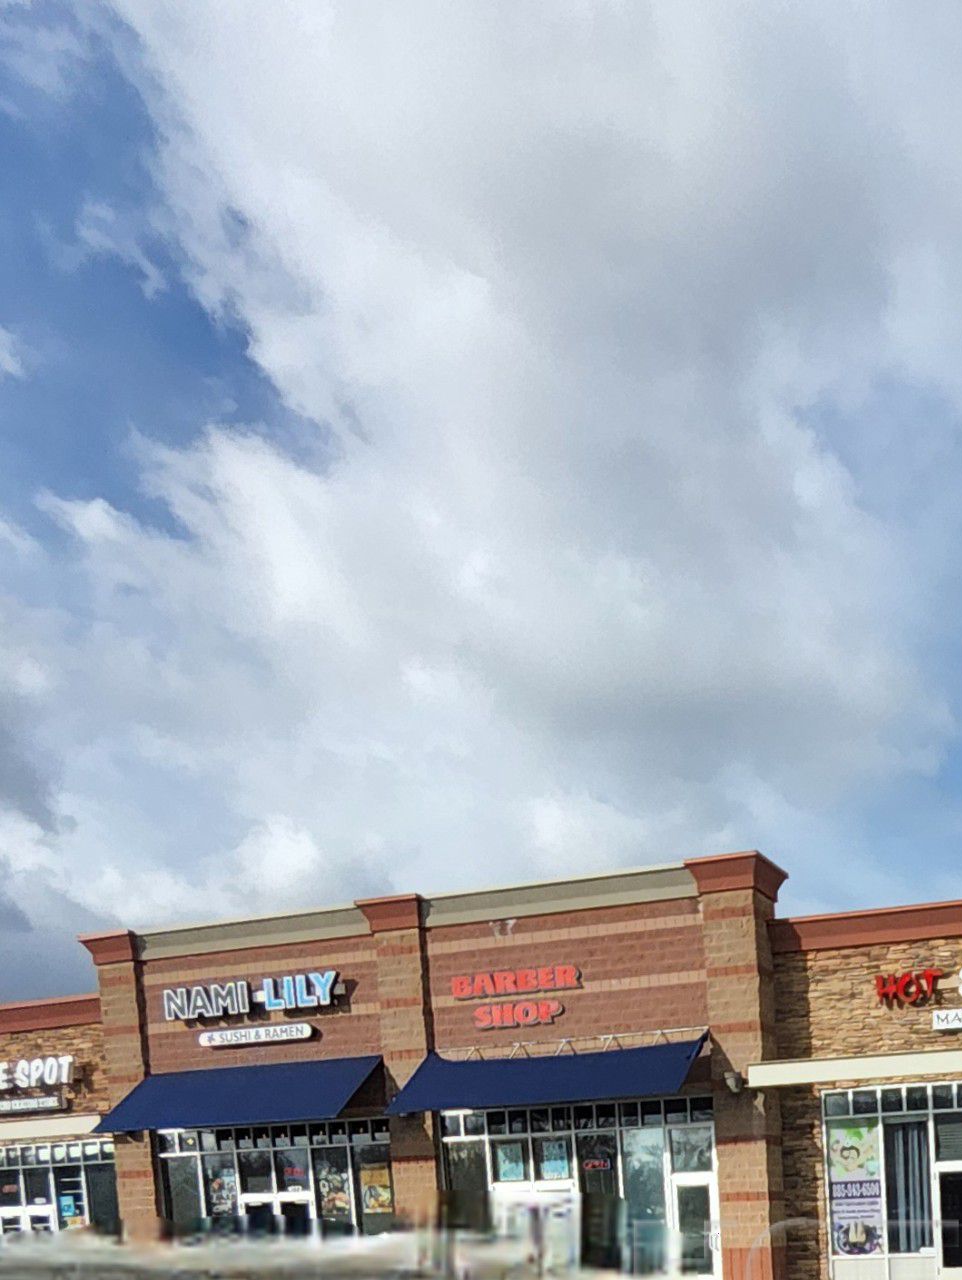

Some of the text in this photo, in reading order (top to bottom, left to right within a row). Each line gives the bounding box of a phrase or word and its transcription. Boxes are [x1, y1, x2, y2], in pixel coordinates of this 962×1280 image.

[163, 970, 338, 1021] NAMI LILY
[452, 964, 581, 999] BARBER
[875, 968, 943, 1004] HOT
[473, 999, 562, 1029] SHOP
[219, 1026, 304, 1043] SUSHI & RAMEN
[14, 1055, 73, 1088] SPOT
